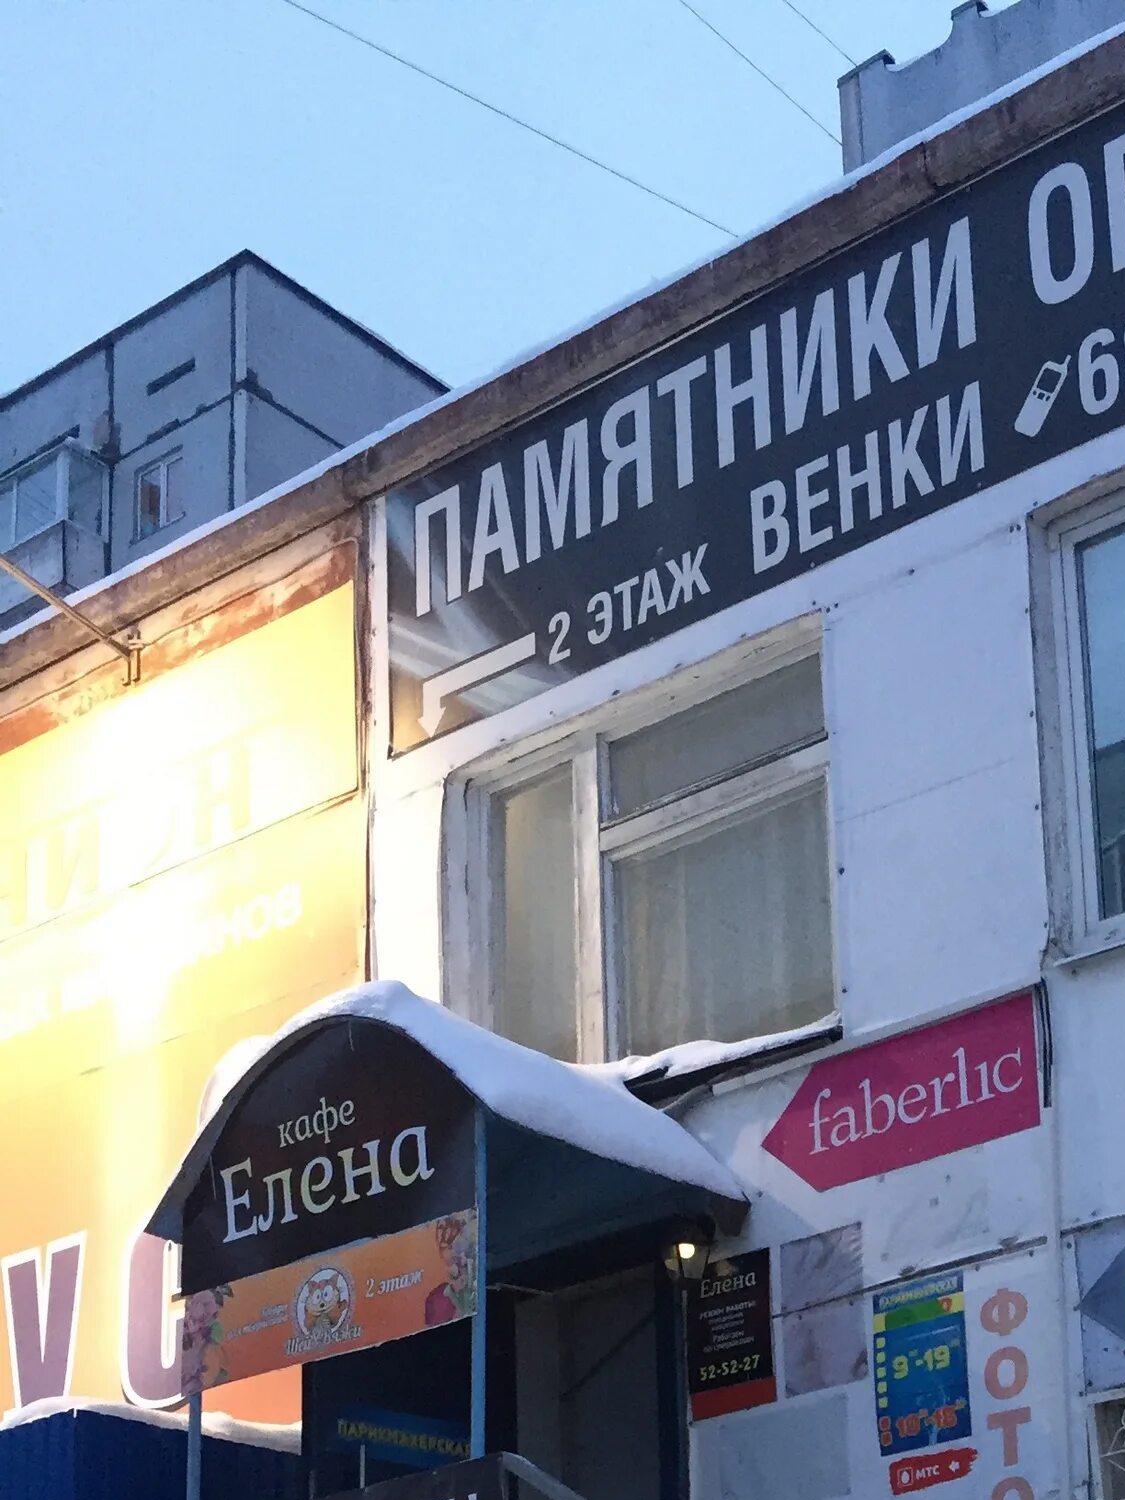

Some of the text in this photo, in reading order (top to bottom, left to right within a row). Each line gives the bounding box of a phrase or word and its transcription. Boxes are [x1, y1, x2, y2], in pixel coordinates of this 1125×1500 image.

[415, 216, 976, 616] ПАМЯТНИКИ
[547, 381, 985, 664] 2 ЭТАЖ ВЕНКИ
[279, 1096, 356, 1148] кафе
[809, 1047, 1022, 1155] faberlic
[220, 1126, 434, 1243] Елена
[366, 1278, 375, 1298] 2
[700, 1271, 757, 1298] Елена
[700, 1354, 761, 1381] 52-52-27
